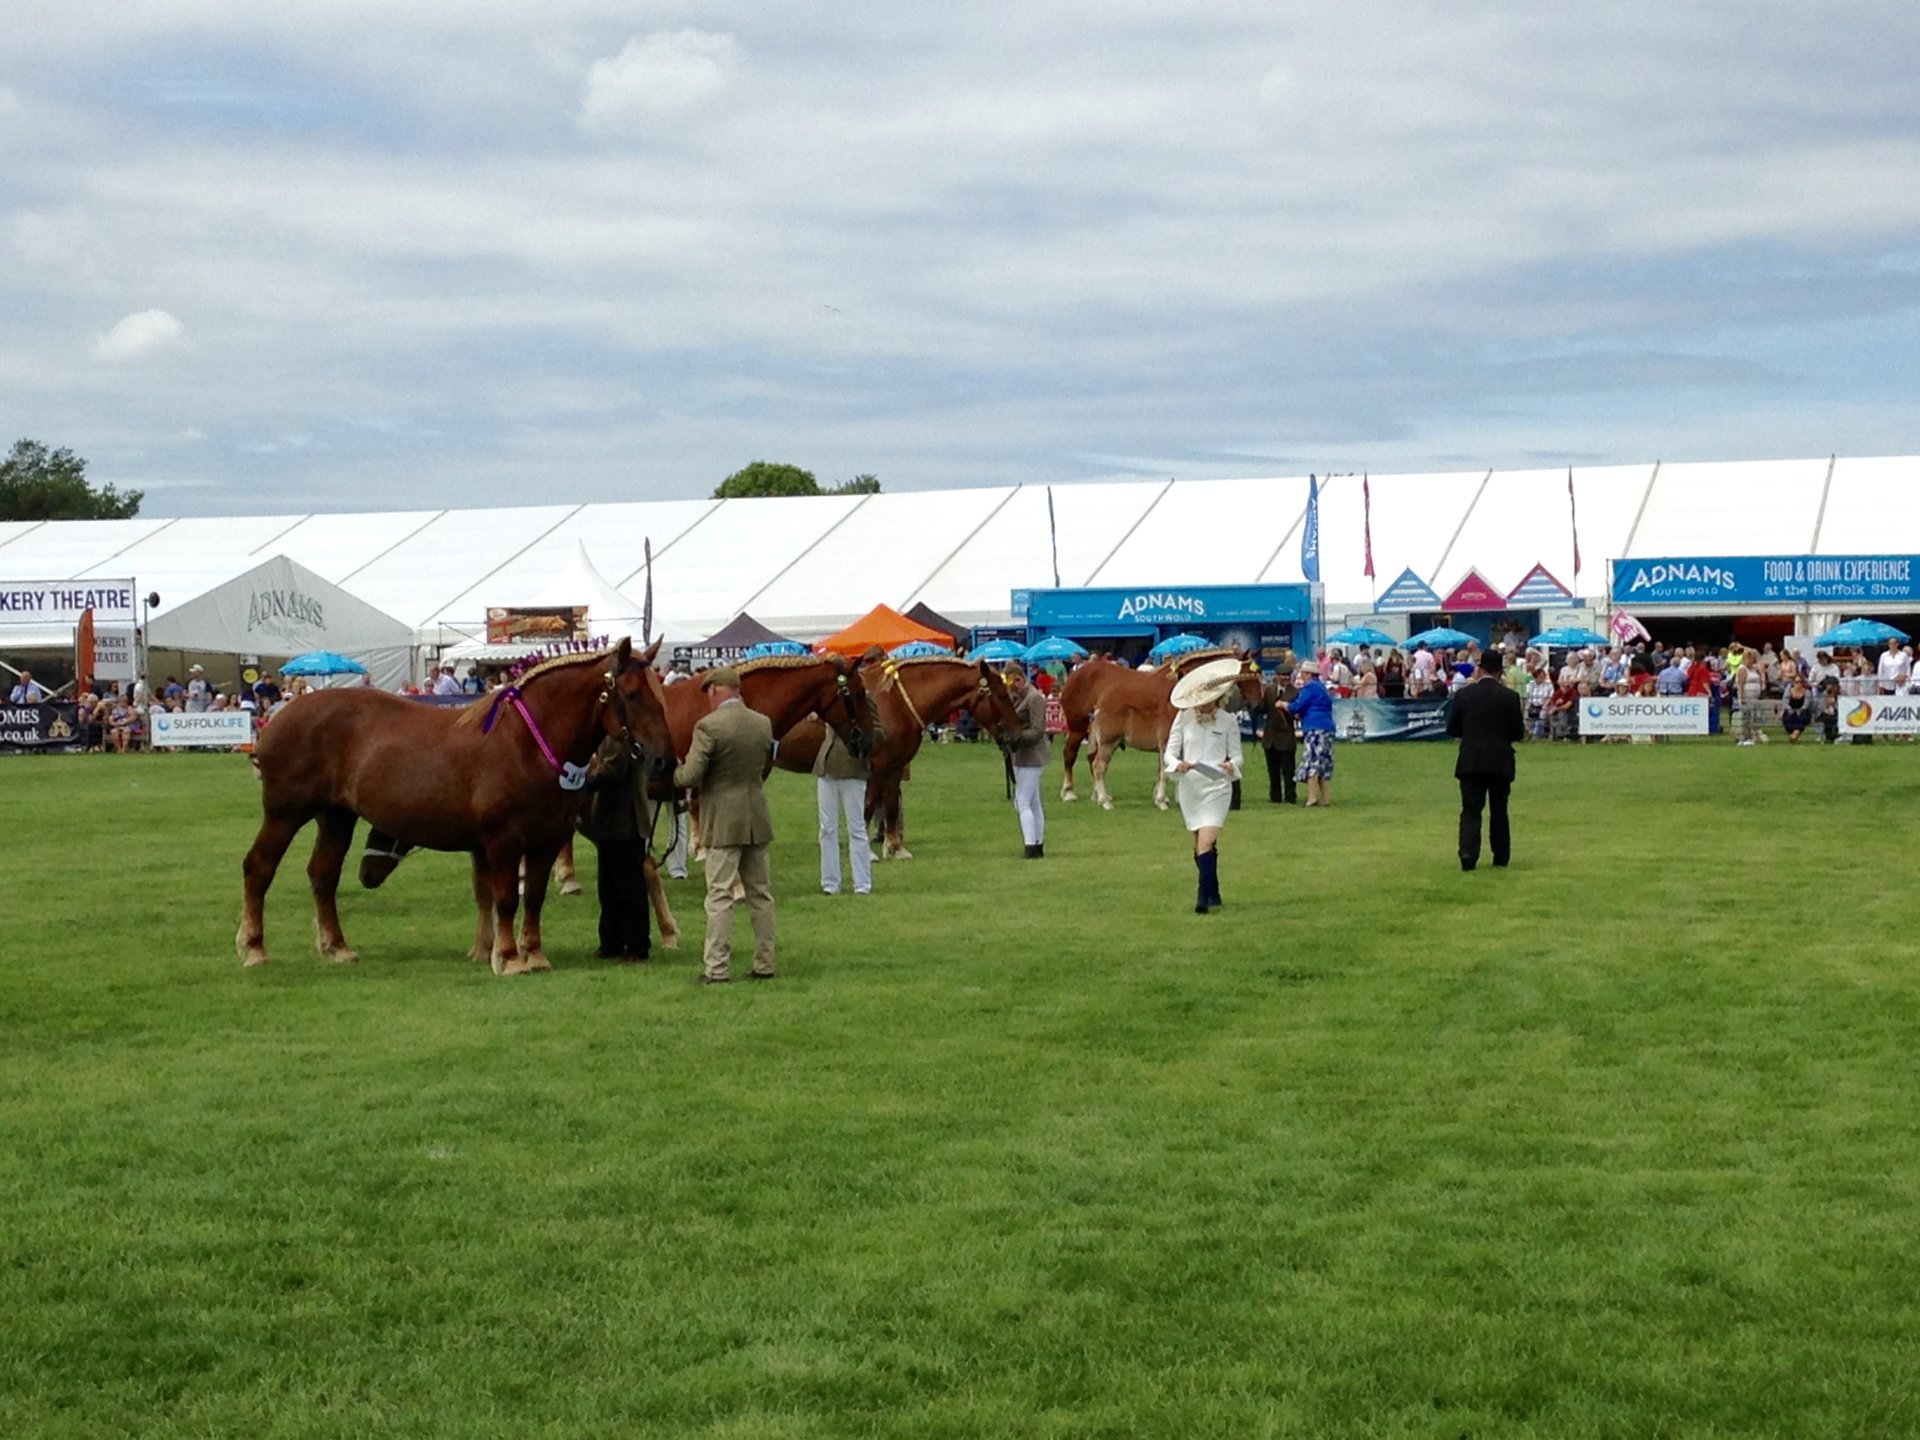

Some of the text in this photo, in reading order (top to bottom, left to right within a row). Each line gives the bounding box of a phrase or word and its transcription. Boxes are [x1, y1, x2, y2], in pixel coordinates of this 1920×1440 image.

[1630, 564, 1735, 592] ADNAMS
[1764, 560, 1911, 581] FOOD & DRINK EXPERIENCE
[1651, 587, 1719, 597] SOUTHWOLD
[1765, 584, 1911, 596] at the Suffolk Show
[50, 589, 131, 610] THEATRE
[1117, 594, 1206, 619] ADNAMS
[248, 591, 326, 632] ADNAMS
[1135, 614, 1192, 624] SOUTHWOLD
[94, 636, 127, 648] OKERY
[692, 648, 717, 659] HIGH
[1875, 706, 1920, 721] AVAN
[0, 727, 40, 742] .co.uk
